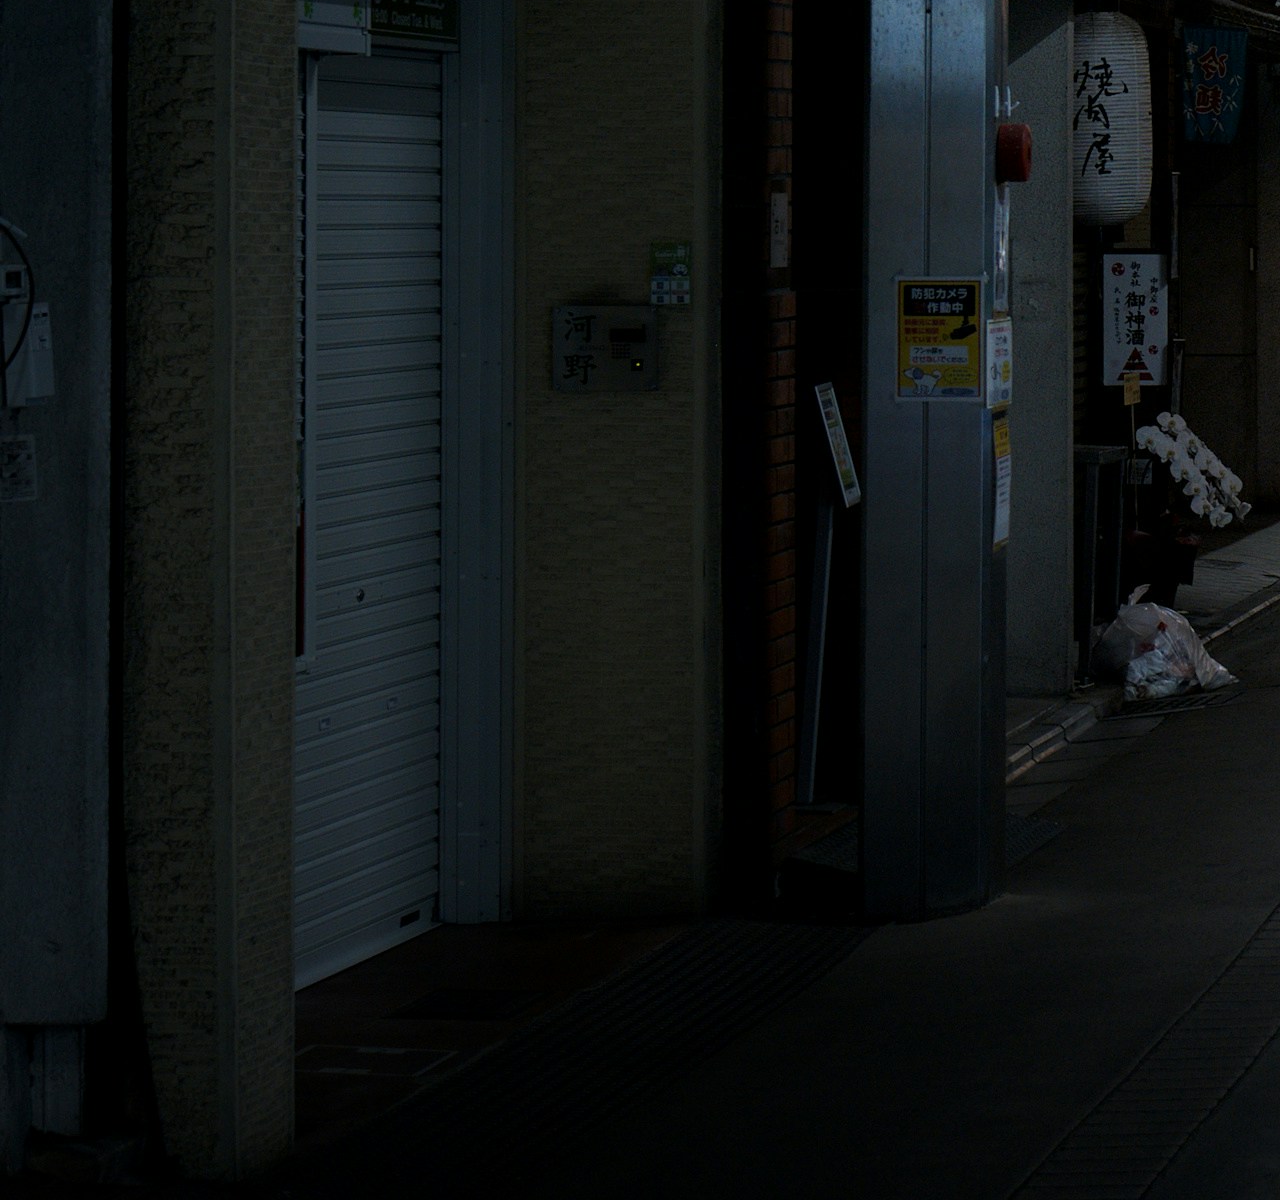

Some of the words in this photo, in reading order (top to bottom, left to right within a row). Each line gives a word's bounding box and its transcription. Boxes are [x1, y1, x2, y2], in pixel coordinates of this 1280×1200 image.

[1073, 57, 1129, 177] 焼肉屋
[911, 287, 968, 300] 防犯カメラ
[926, 301, 964, 314] 作動中
[1124, 290, 1146, 346] 御神酒
[562, 311, 598, 386] 河野
